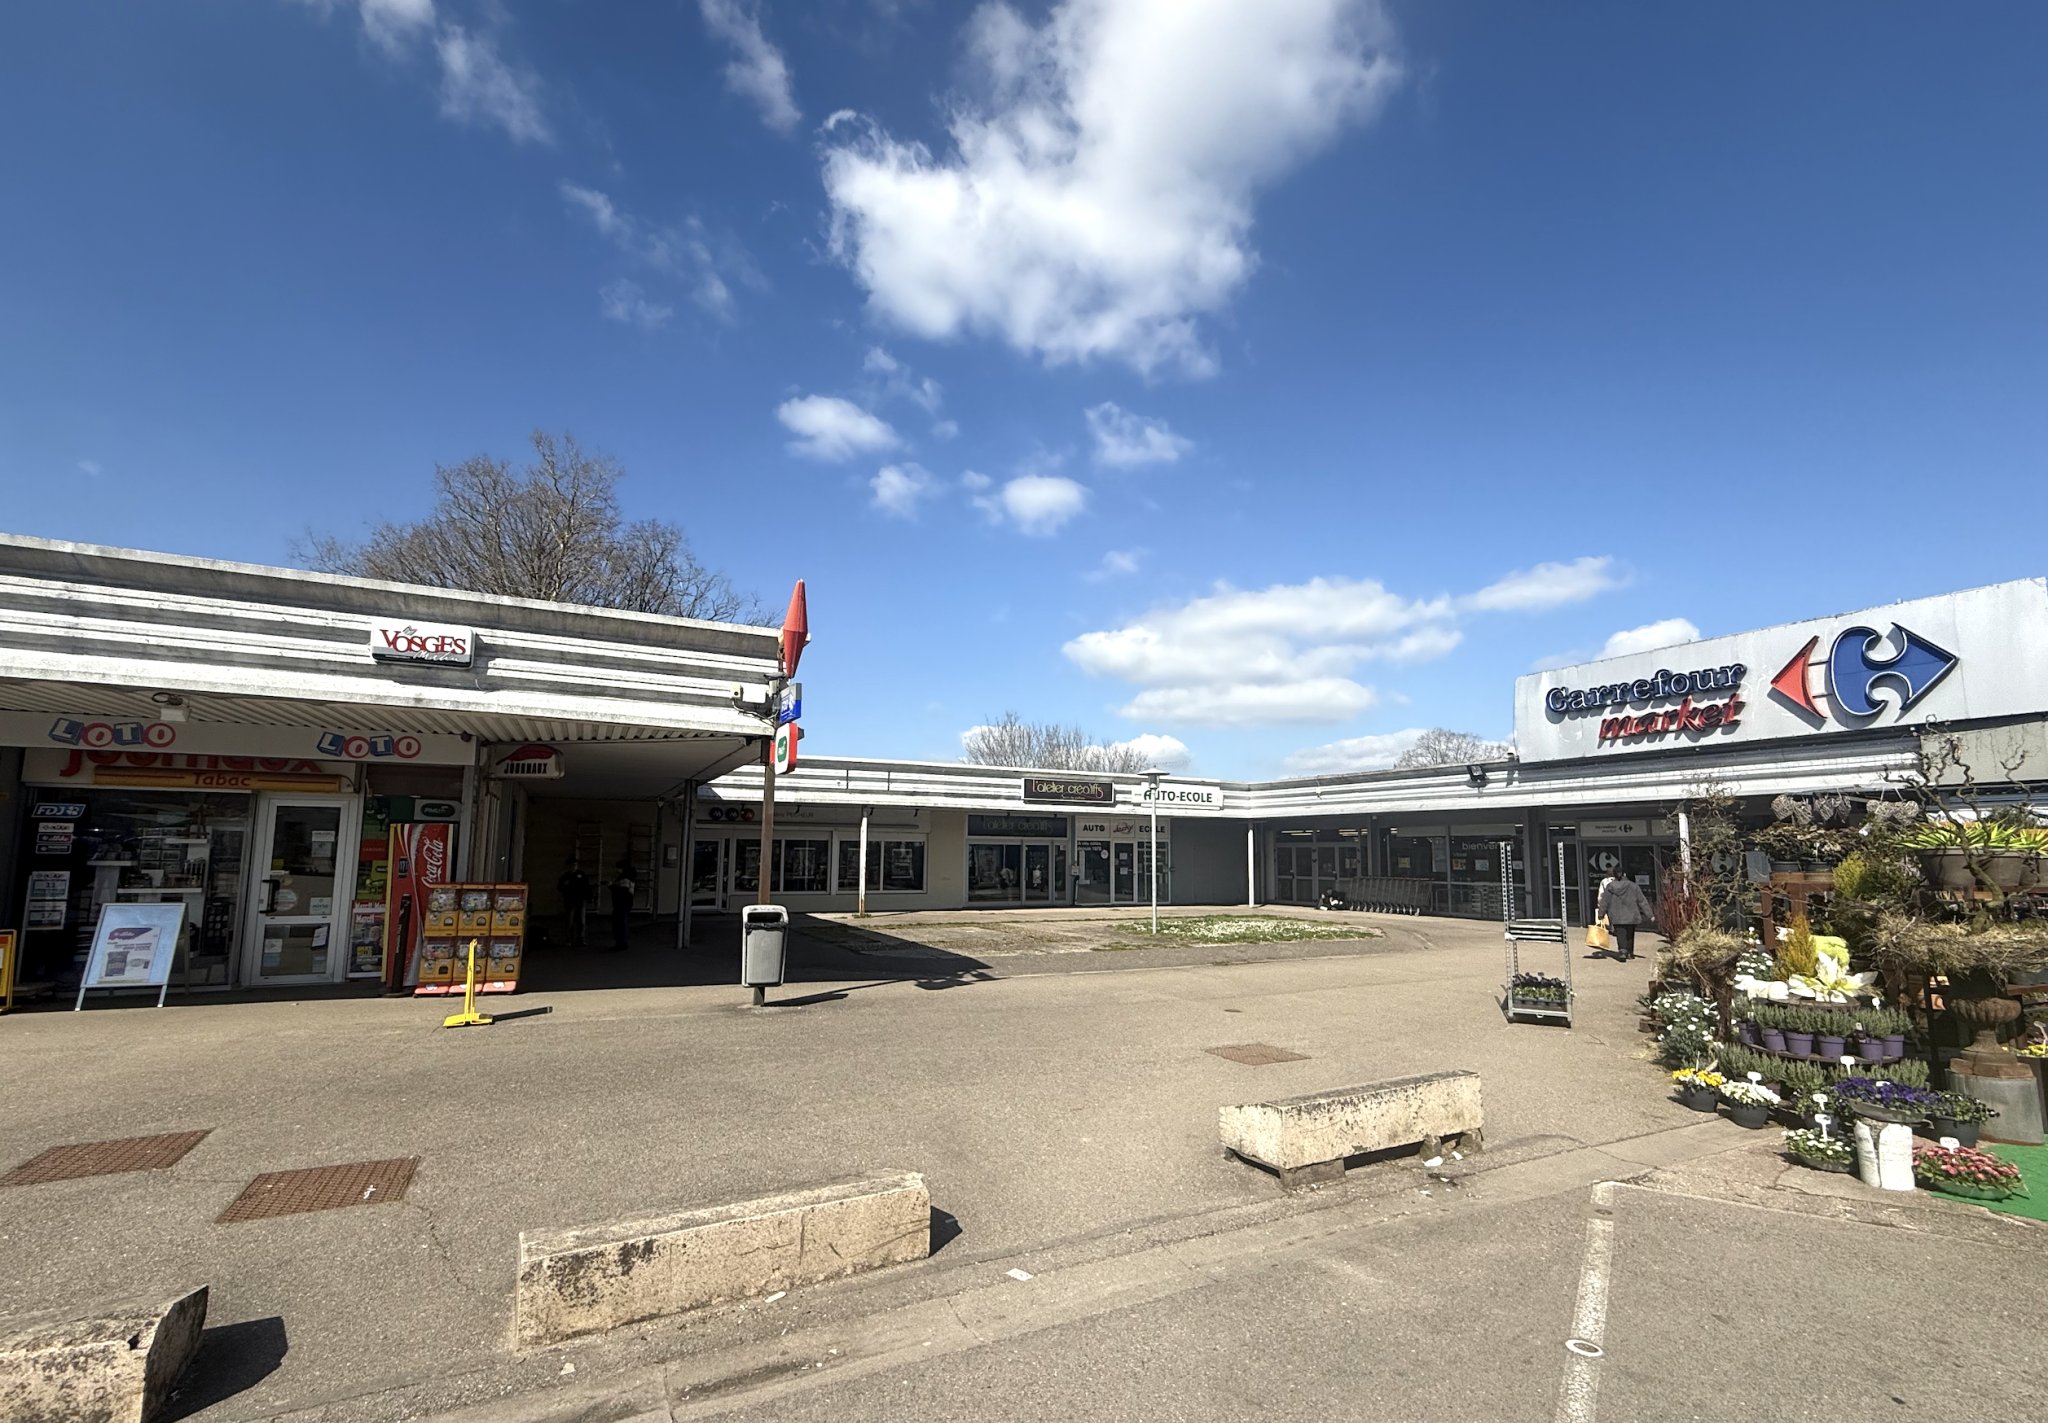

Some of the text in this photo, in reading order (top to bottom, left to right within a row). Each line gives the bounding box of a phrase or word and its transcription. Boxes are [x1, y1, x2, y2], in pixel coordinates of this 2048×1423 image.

[379, 629, 467, 655] VOSGES
[1546, 663, 1747, 713] Carrefour
[1599, 692, 1745, 740] market
[48, 717, 176, 748] LOTO
[316, 731, 422, 759] LOTO
[192, 771, 251, 787] Tabac
[503, 762, 548, 775] JOURNAUX
[36, 805, 66, 816] FDJ
[1082, 824, 1106, 832] AUTO
[1139, 825, 1166, 833] ECLE
[421, 837, 444, 888] Coca-Cola
